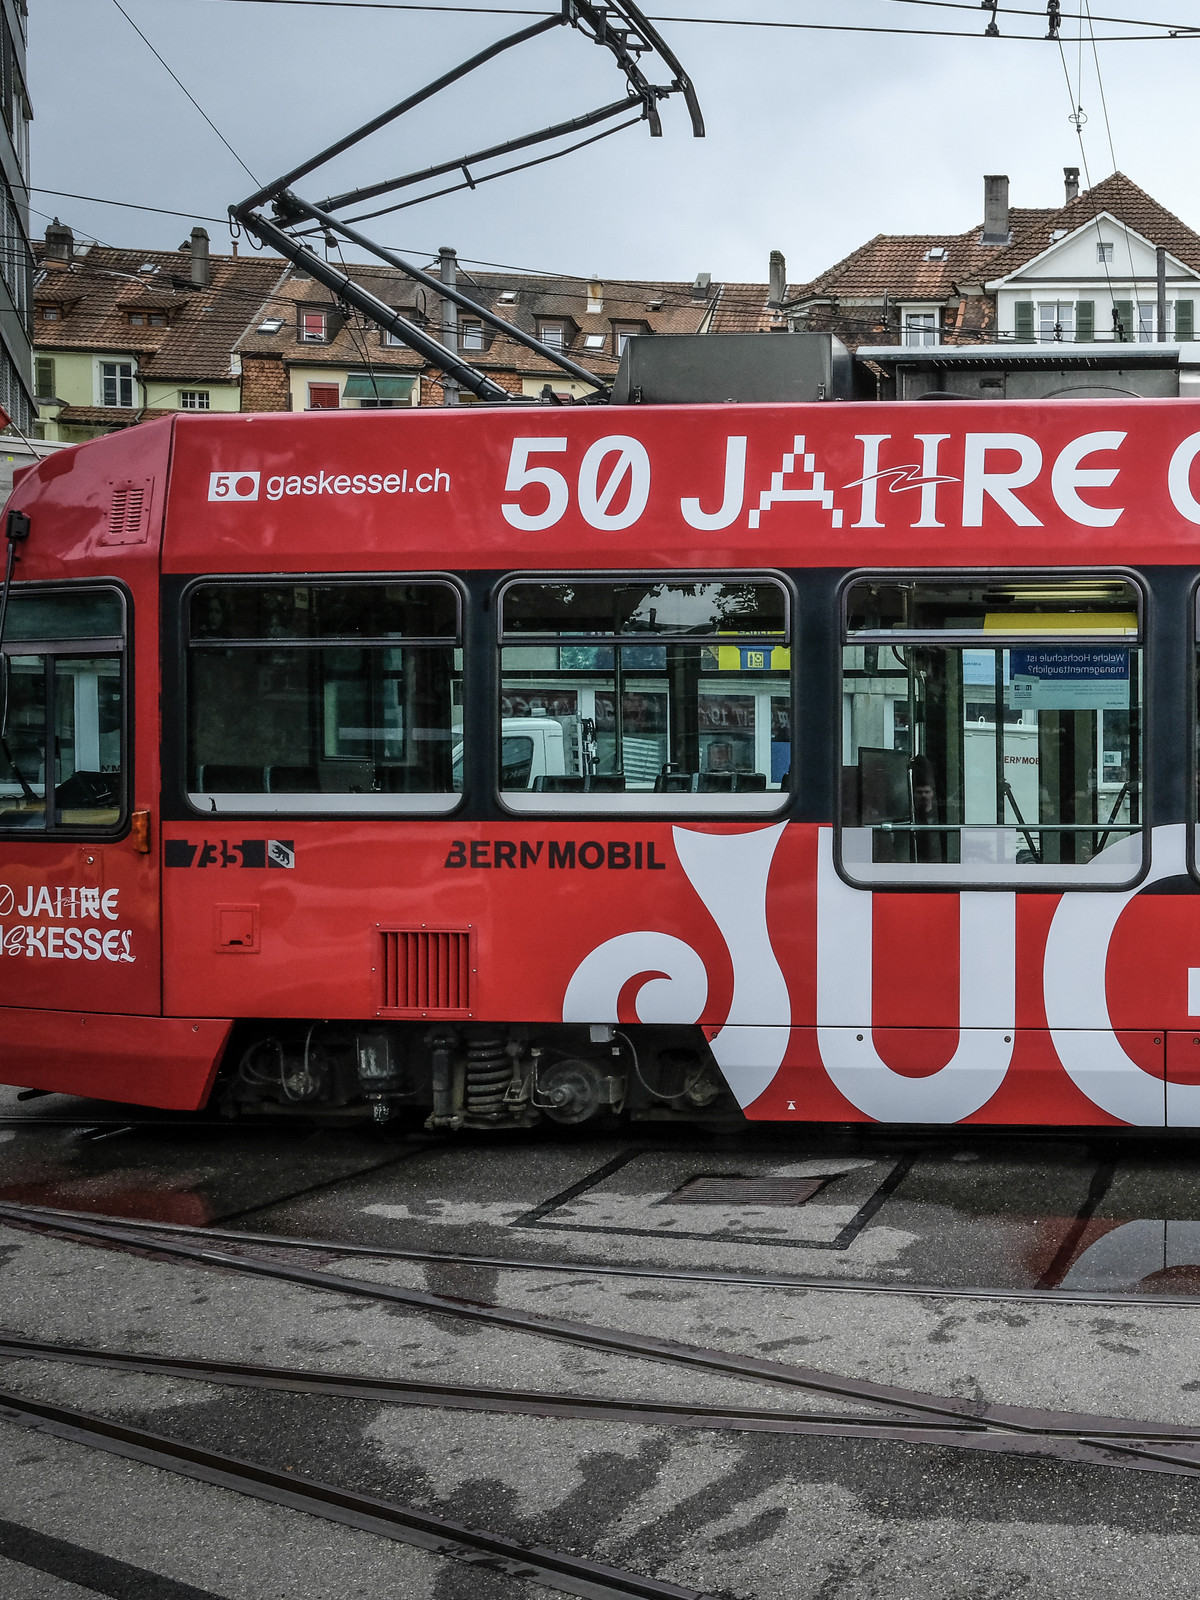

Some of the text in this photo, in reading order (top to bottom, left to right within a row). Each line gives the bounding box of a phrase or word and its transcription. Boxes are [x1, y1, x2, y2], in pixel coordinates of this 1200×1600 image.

[266, 468, 450, 501] gaskessel.ch
[501, 435, 651, 531] 50
[680, 430, 1127, 531] JAHRE
[187, 840, 244, 868] 735
[18, 885, 120, 920] JAHRE
[0, 925, 136, 963] SKESSEL
